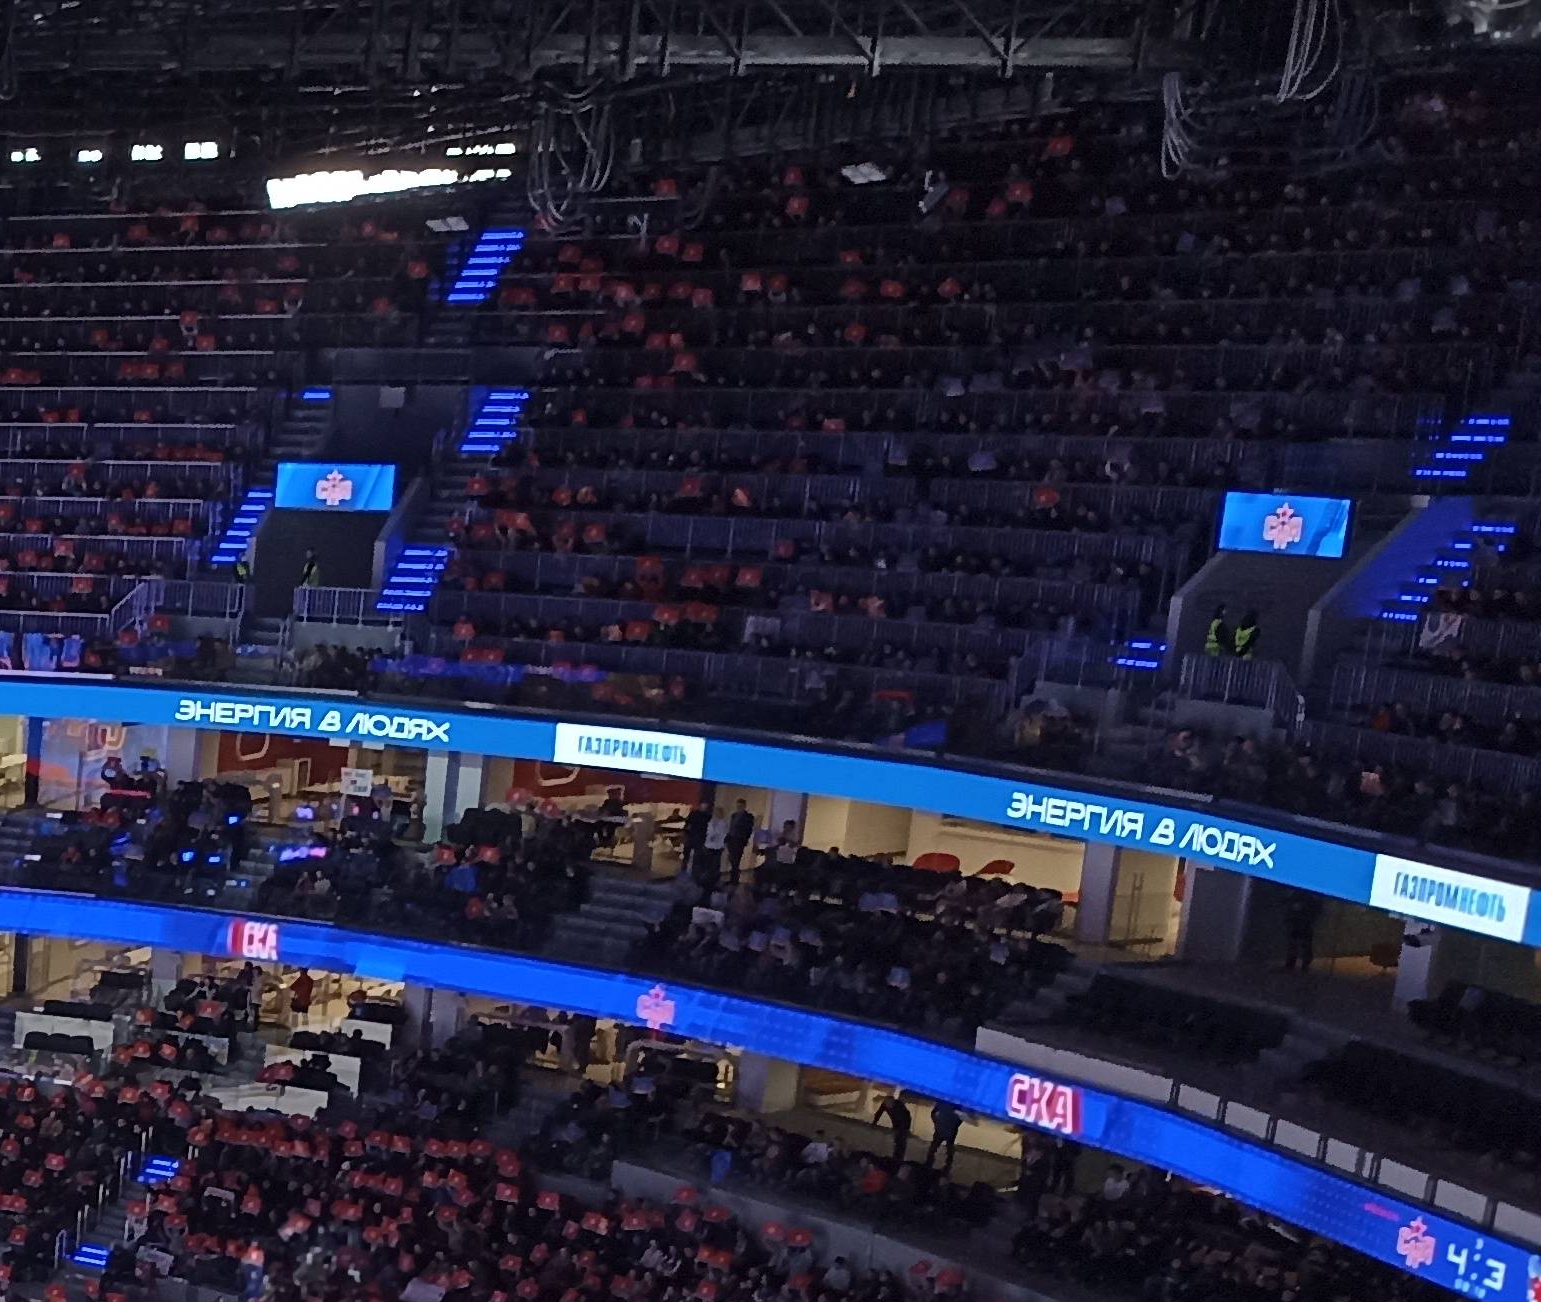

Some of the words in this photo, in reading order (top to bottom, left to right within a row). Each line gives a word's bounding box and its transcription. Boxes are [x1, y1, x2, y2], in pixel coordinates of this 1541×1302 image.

[175, 700, 312, 729] ЭНЕРГИЯ
[318, 710, 341, 732] В
[345, 711, 450, 743] ЛЮДЯХ
[1006, 791, 1145, 840] ЭНЕРГИЯ
[1149, 818, 1175, 846] В
[1179, 823, 1277, 869] ЛЮДЯХ
[1005, 1072, 1074, 1135] СКА
